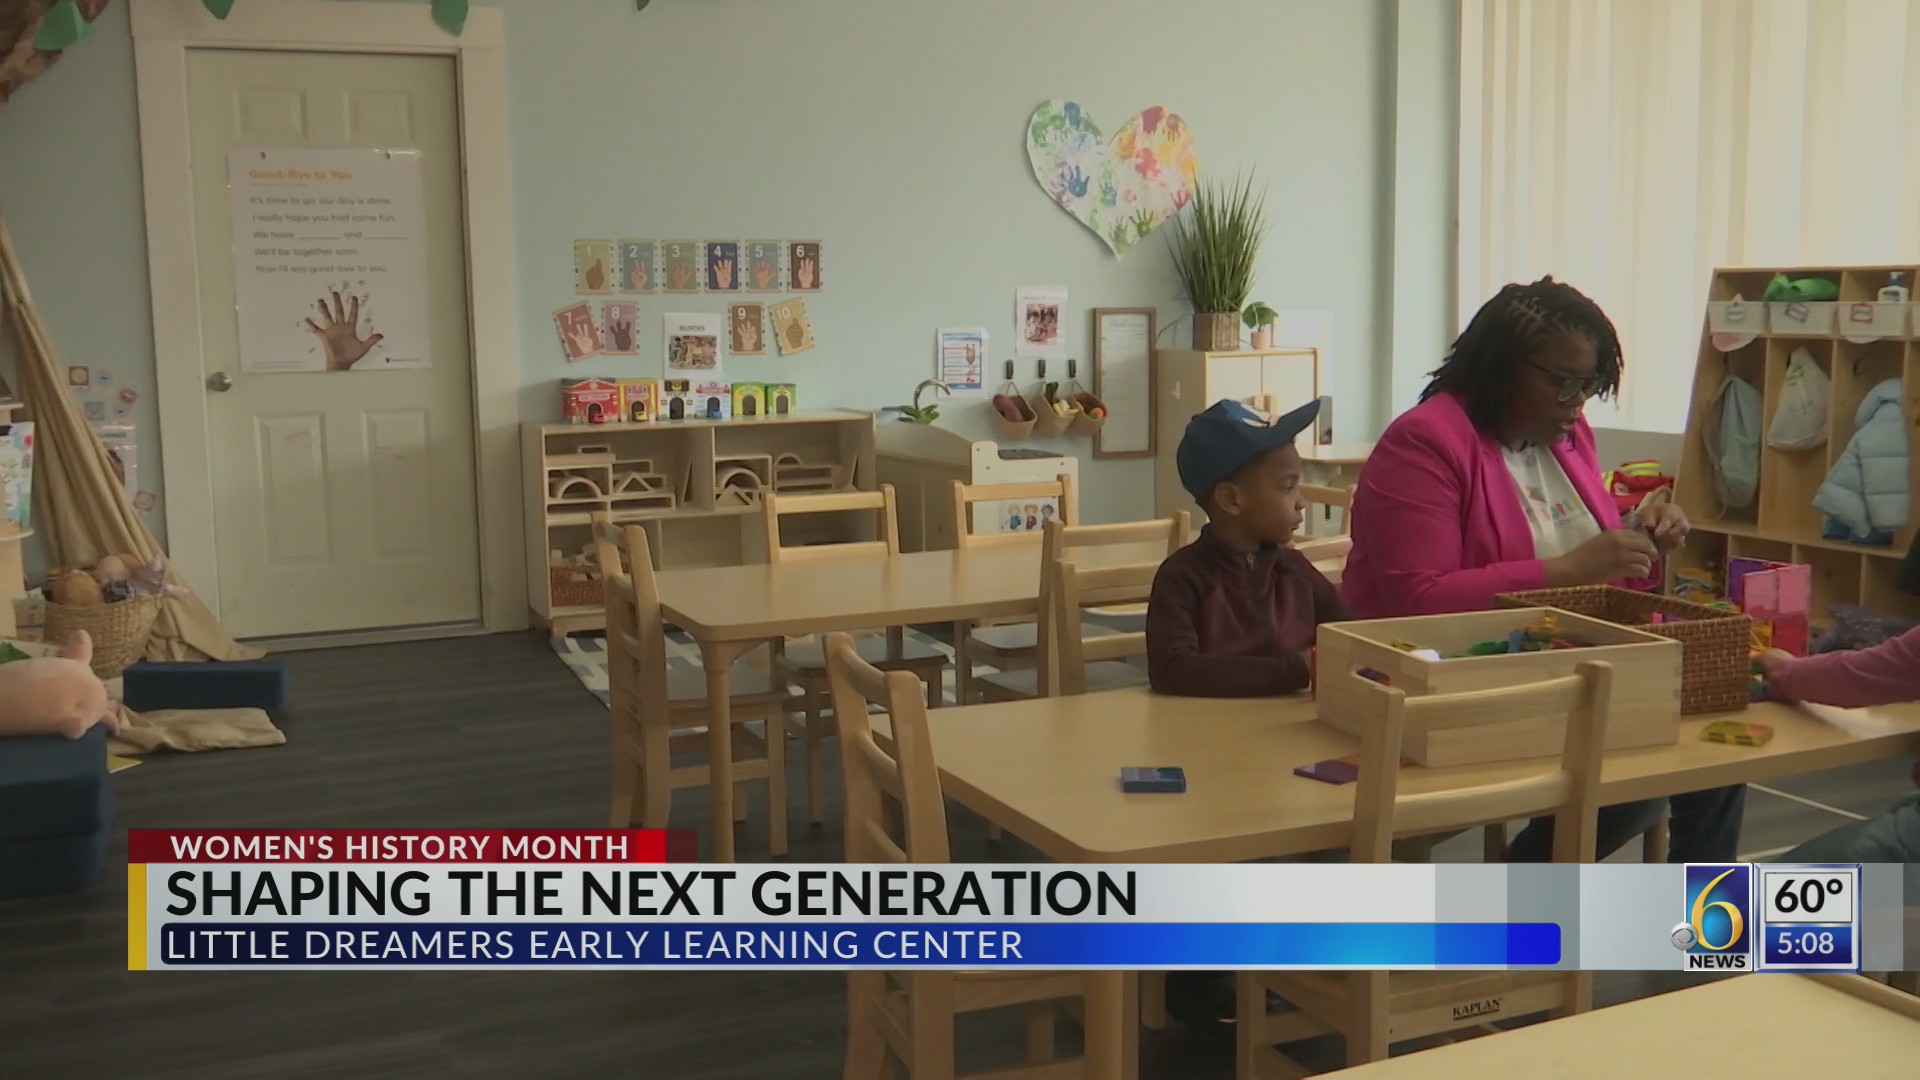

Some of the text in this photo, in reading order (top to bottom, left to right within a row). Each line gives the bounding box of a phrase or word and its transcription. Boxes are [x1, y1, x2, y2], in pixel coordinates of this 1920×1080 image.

[315, 170, 326, 180] to
[290, 196, 300, 204] to
[337, 196, 354, 206] day
[258, 214, 283, 223] really
[285, 214, 309, 223] hope
[331, 214, 350, 222] had
[343, 231, 362, 239] and
[293, 248, 333, 257] together
[585, 245, 592, 257] 1
[628, 245, 638, 258] 2
[671, 245, 681, 258] 3
[713, 245, 722, 257] 4
[754, 245, 763, 257] 5
[796, 245, 805, 257] 6
[562, 311, 572, 325] 7
[611, 306, 620, 320] 8
[737, 307, 746, 320] 9
[776, 307, 791, 320] 10
[1453, 998, 1500, 1017] KAPLAN
